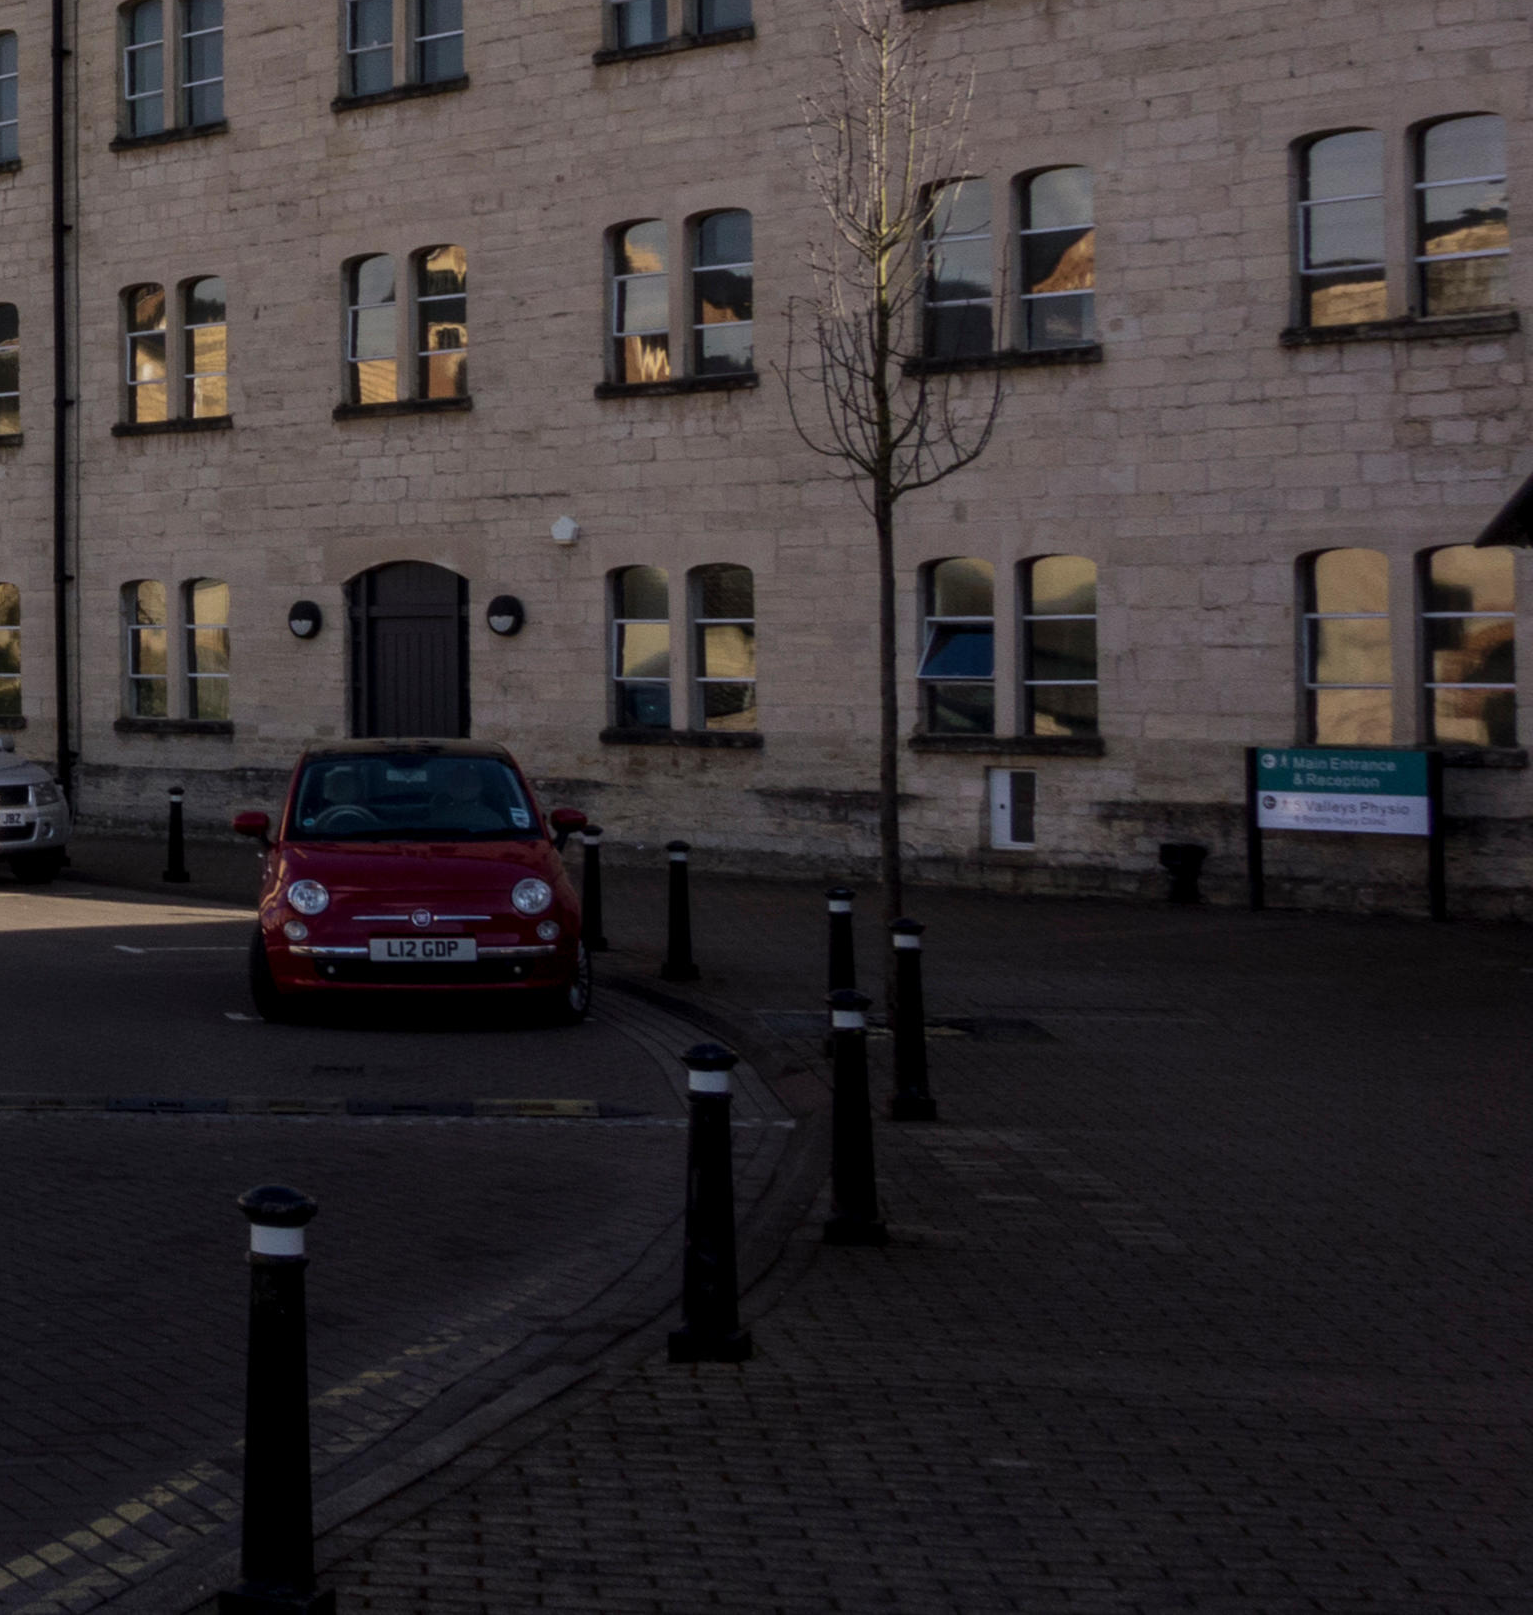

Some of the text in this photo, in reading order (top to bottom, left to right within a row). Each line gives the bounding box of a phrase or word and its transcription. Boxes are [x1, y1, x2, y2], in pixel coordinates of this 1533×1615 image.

[1293, 757, 1397, 772] Main Entrance
[1293, 773, 1380, 789] & Reception
[1307, 801, 1356, 815] Valleys
[1360, 801, 1410, 817] Physio
[422, 940, 459, 957] GDP
